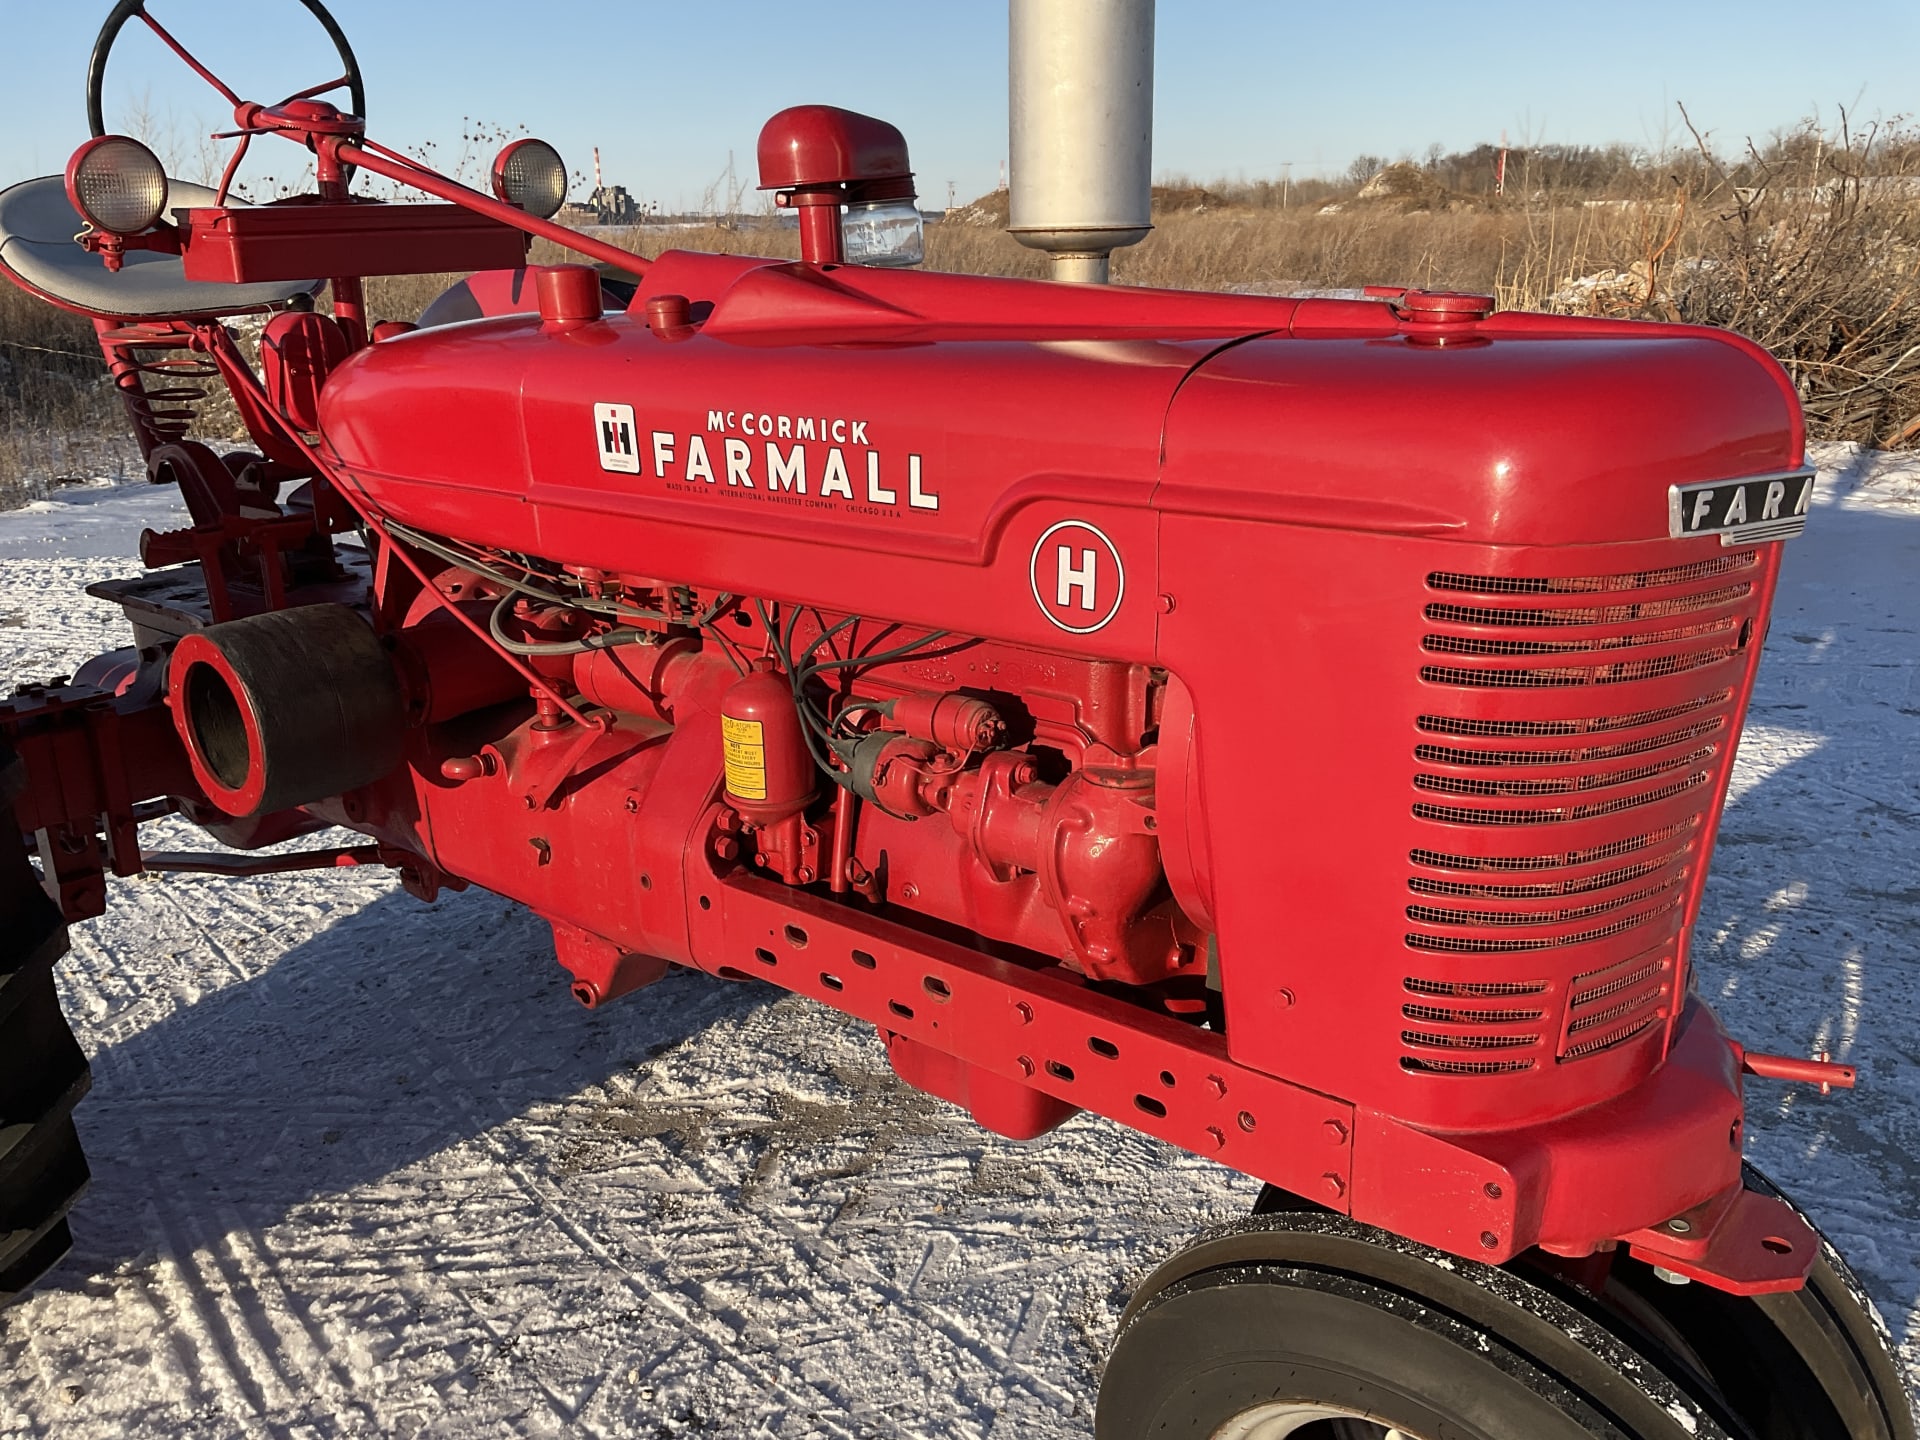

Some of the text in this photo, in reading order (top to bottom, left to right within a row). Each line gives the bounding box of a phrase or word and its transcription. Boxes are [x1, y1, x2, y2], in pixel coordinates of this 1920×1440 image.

[651, 430, 939, 510] FARMALL
[666, 482, 682, 491] MADE
[718, 489, 765, 502] INTERNATIONAL
[767, 495, 802, 506] HARVESTER
[805, 499, 837, 510] COMPANY
[846, 504, 879, 516] CHICAGO
[1056, 544, 1097, 611] H
